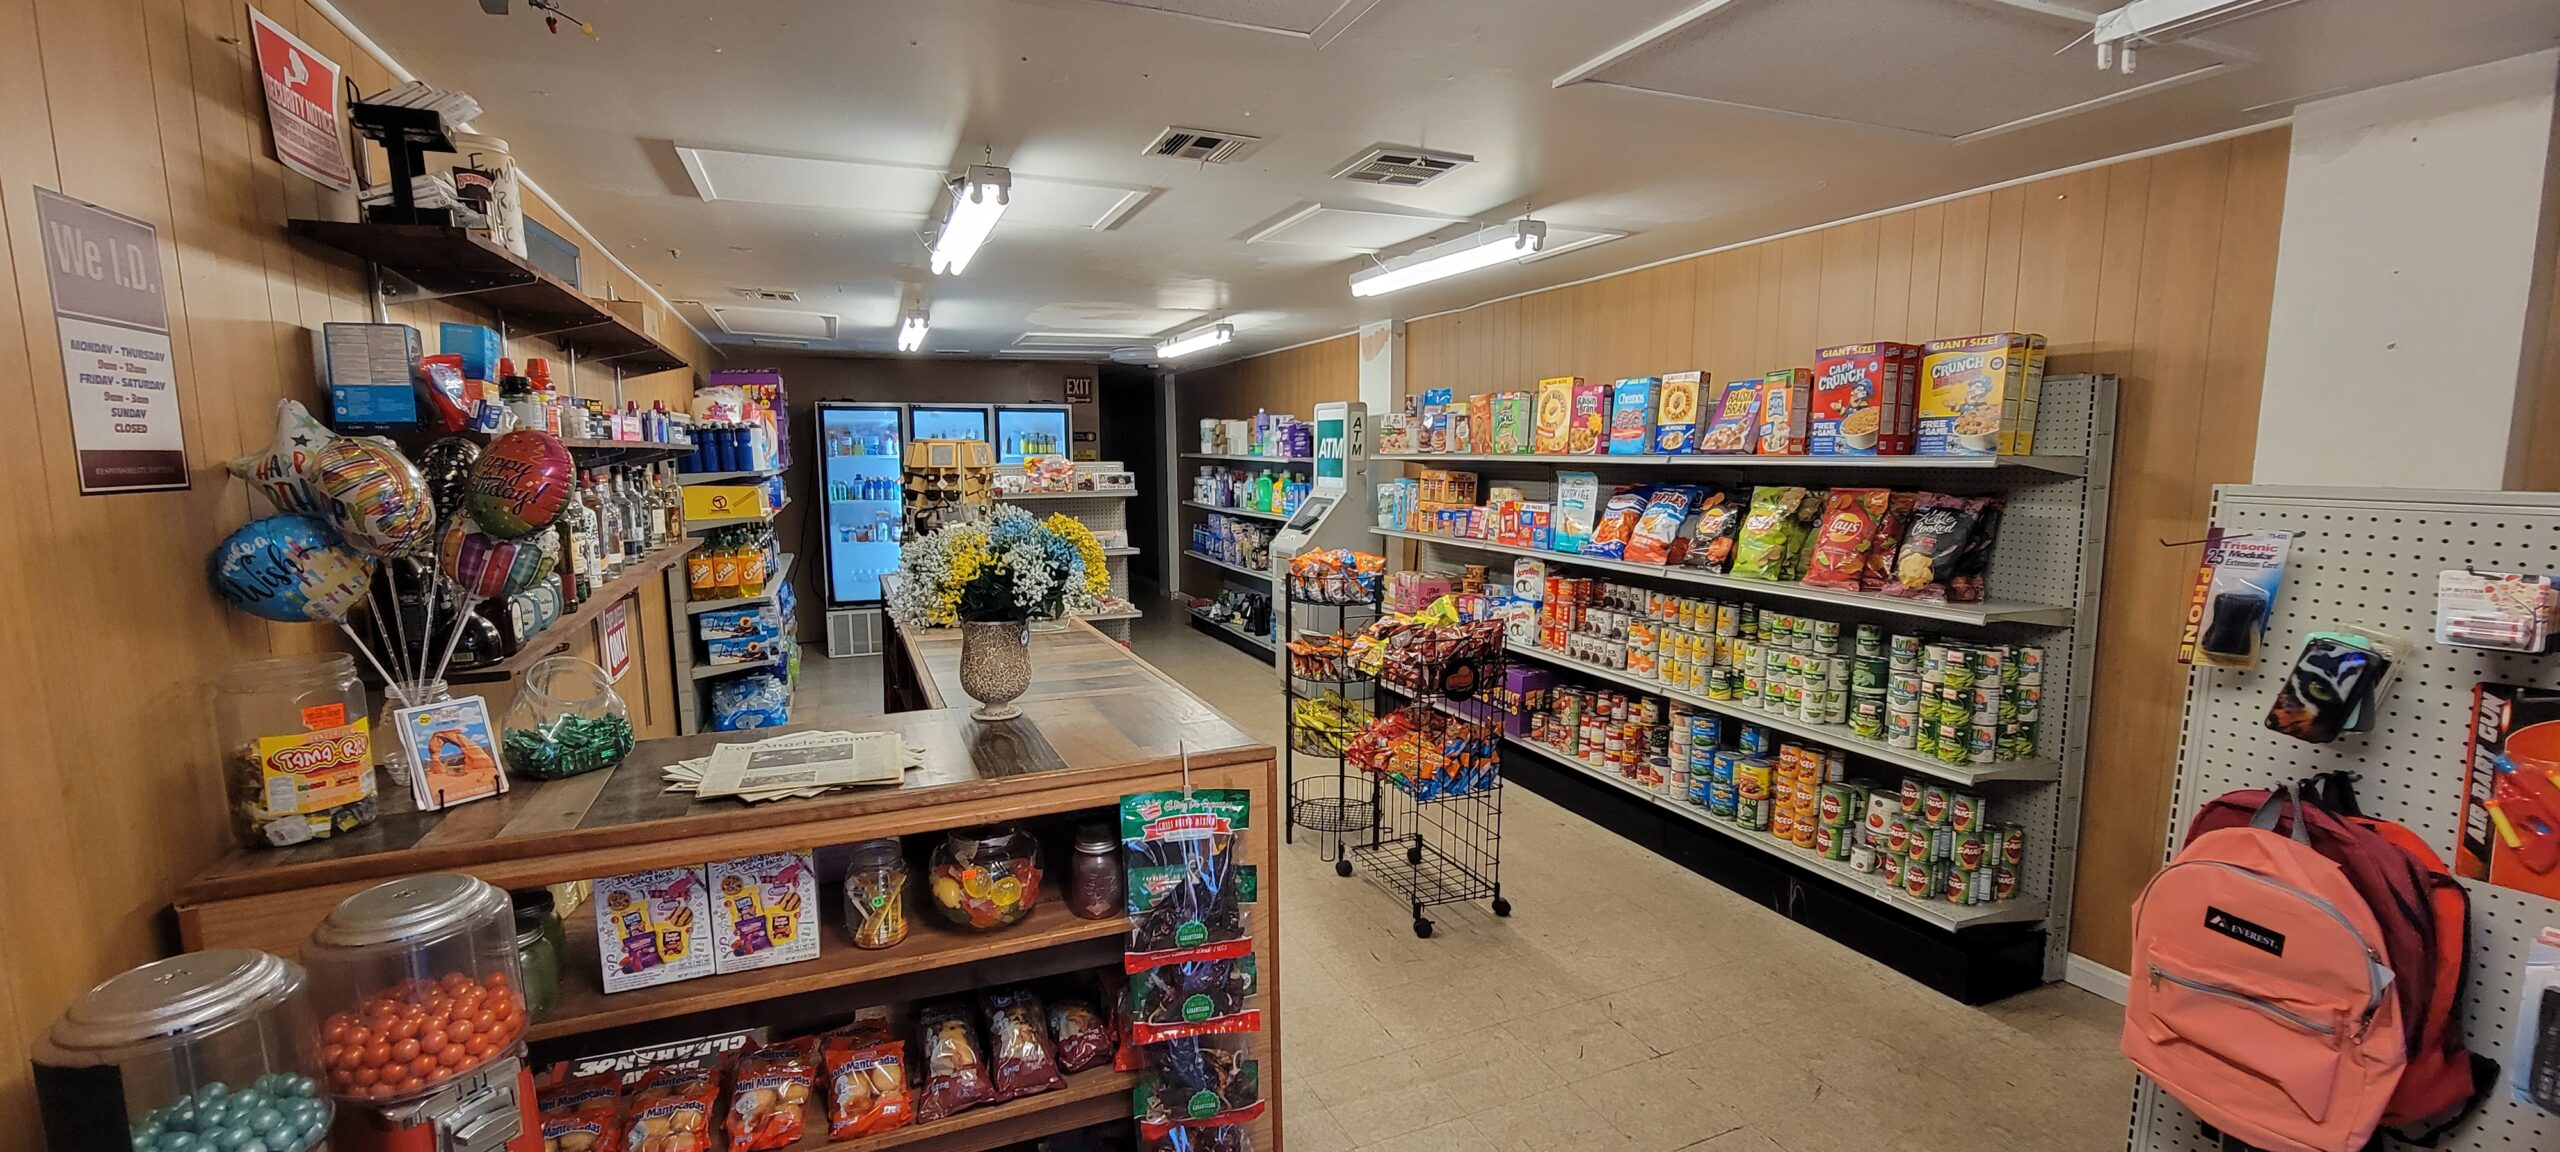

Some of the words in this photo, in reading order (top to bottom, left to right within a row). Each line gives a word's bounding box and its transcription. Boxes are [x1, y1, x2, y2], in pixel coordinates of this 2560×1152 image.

[305, 99, 336, 137] NOTICE
[50, 221, 104, 281] We
[109, 238, 156, 294] I.D.
[71, 339, 112, 355] MONDAY
[120, 347, 166, 362] THURSDAY
[1822, 348, 1850, 358] GIANT
[1853, 344, 1877, 355] SIZE!
[1932, 340, 1966, 350] GIANT
[1969, 335, 1998, 347] SIZE!
[1931, 356, 1985, 379] CRUNCH
[79, 373, 114, 386] FRIDAY
[122, 378, 166, 391] SATURDAY
[1066, 378, 1091, 395] EXIT
[1818, 368, 1867, 391] CRUNCH
[111, 408, 147, 419] SUNDAY
[1726, 402, 1750, 416] BRAN
[114, 423, 148, 434] CLOSED
[1813, 422, 1837, 430] FREE
[1920, 420, 1947, 428] FREE
[1925, 428, 1948, 436] GAME
[1351, 416, 1362, 457] ATM
[1817, 429, 1837, 437] GAME
[1317, 437, 1344, 460] ATM
[1916, 509, 1956, 525] Kettle
[1911, 520, 1957, 536] Cooked
[2223, 541, 2279, 553] Trisonic
[2207, 549, 2225, 565] 25
[2228, 550, 2277, 560] Modular
[2225, 559, 2260, 568] Extension
[2262, 561, 2280, 569] Cord
[222, 540, 318, 604] Wish
[715, 562, 736, 583] Crush
[2179, 567, 2213, 661] PHONE
[2477, 692, 2508, 743] GUN
[760, 739, 826, 749] Angeles
[2471, 745, 2495, 799] DART
[2466, 800, 2488, 846] AIR
[742, 862, 765, 873] SNACK
[765, 856, 785, 866] PACKS
[630, 875, 653, 886] SNACK
[655, 869, 675, 881] PACKS
[2231, 923, 2278, 950] EVEREST
[573, 1035, 747, 1077] CLEARANCE
[846, 1055, 899, 1074] Mantecadas
[735, 1079, 754, 1093] Mini
[755, 1076, 811, 1088] Mantecadas
[557, 1087, 616, 1108] Mantecadas
[646, 1101, 705, 1118] Mantecadas
